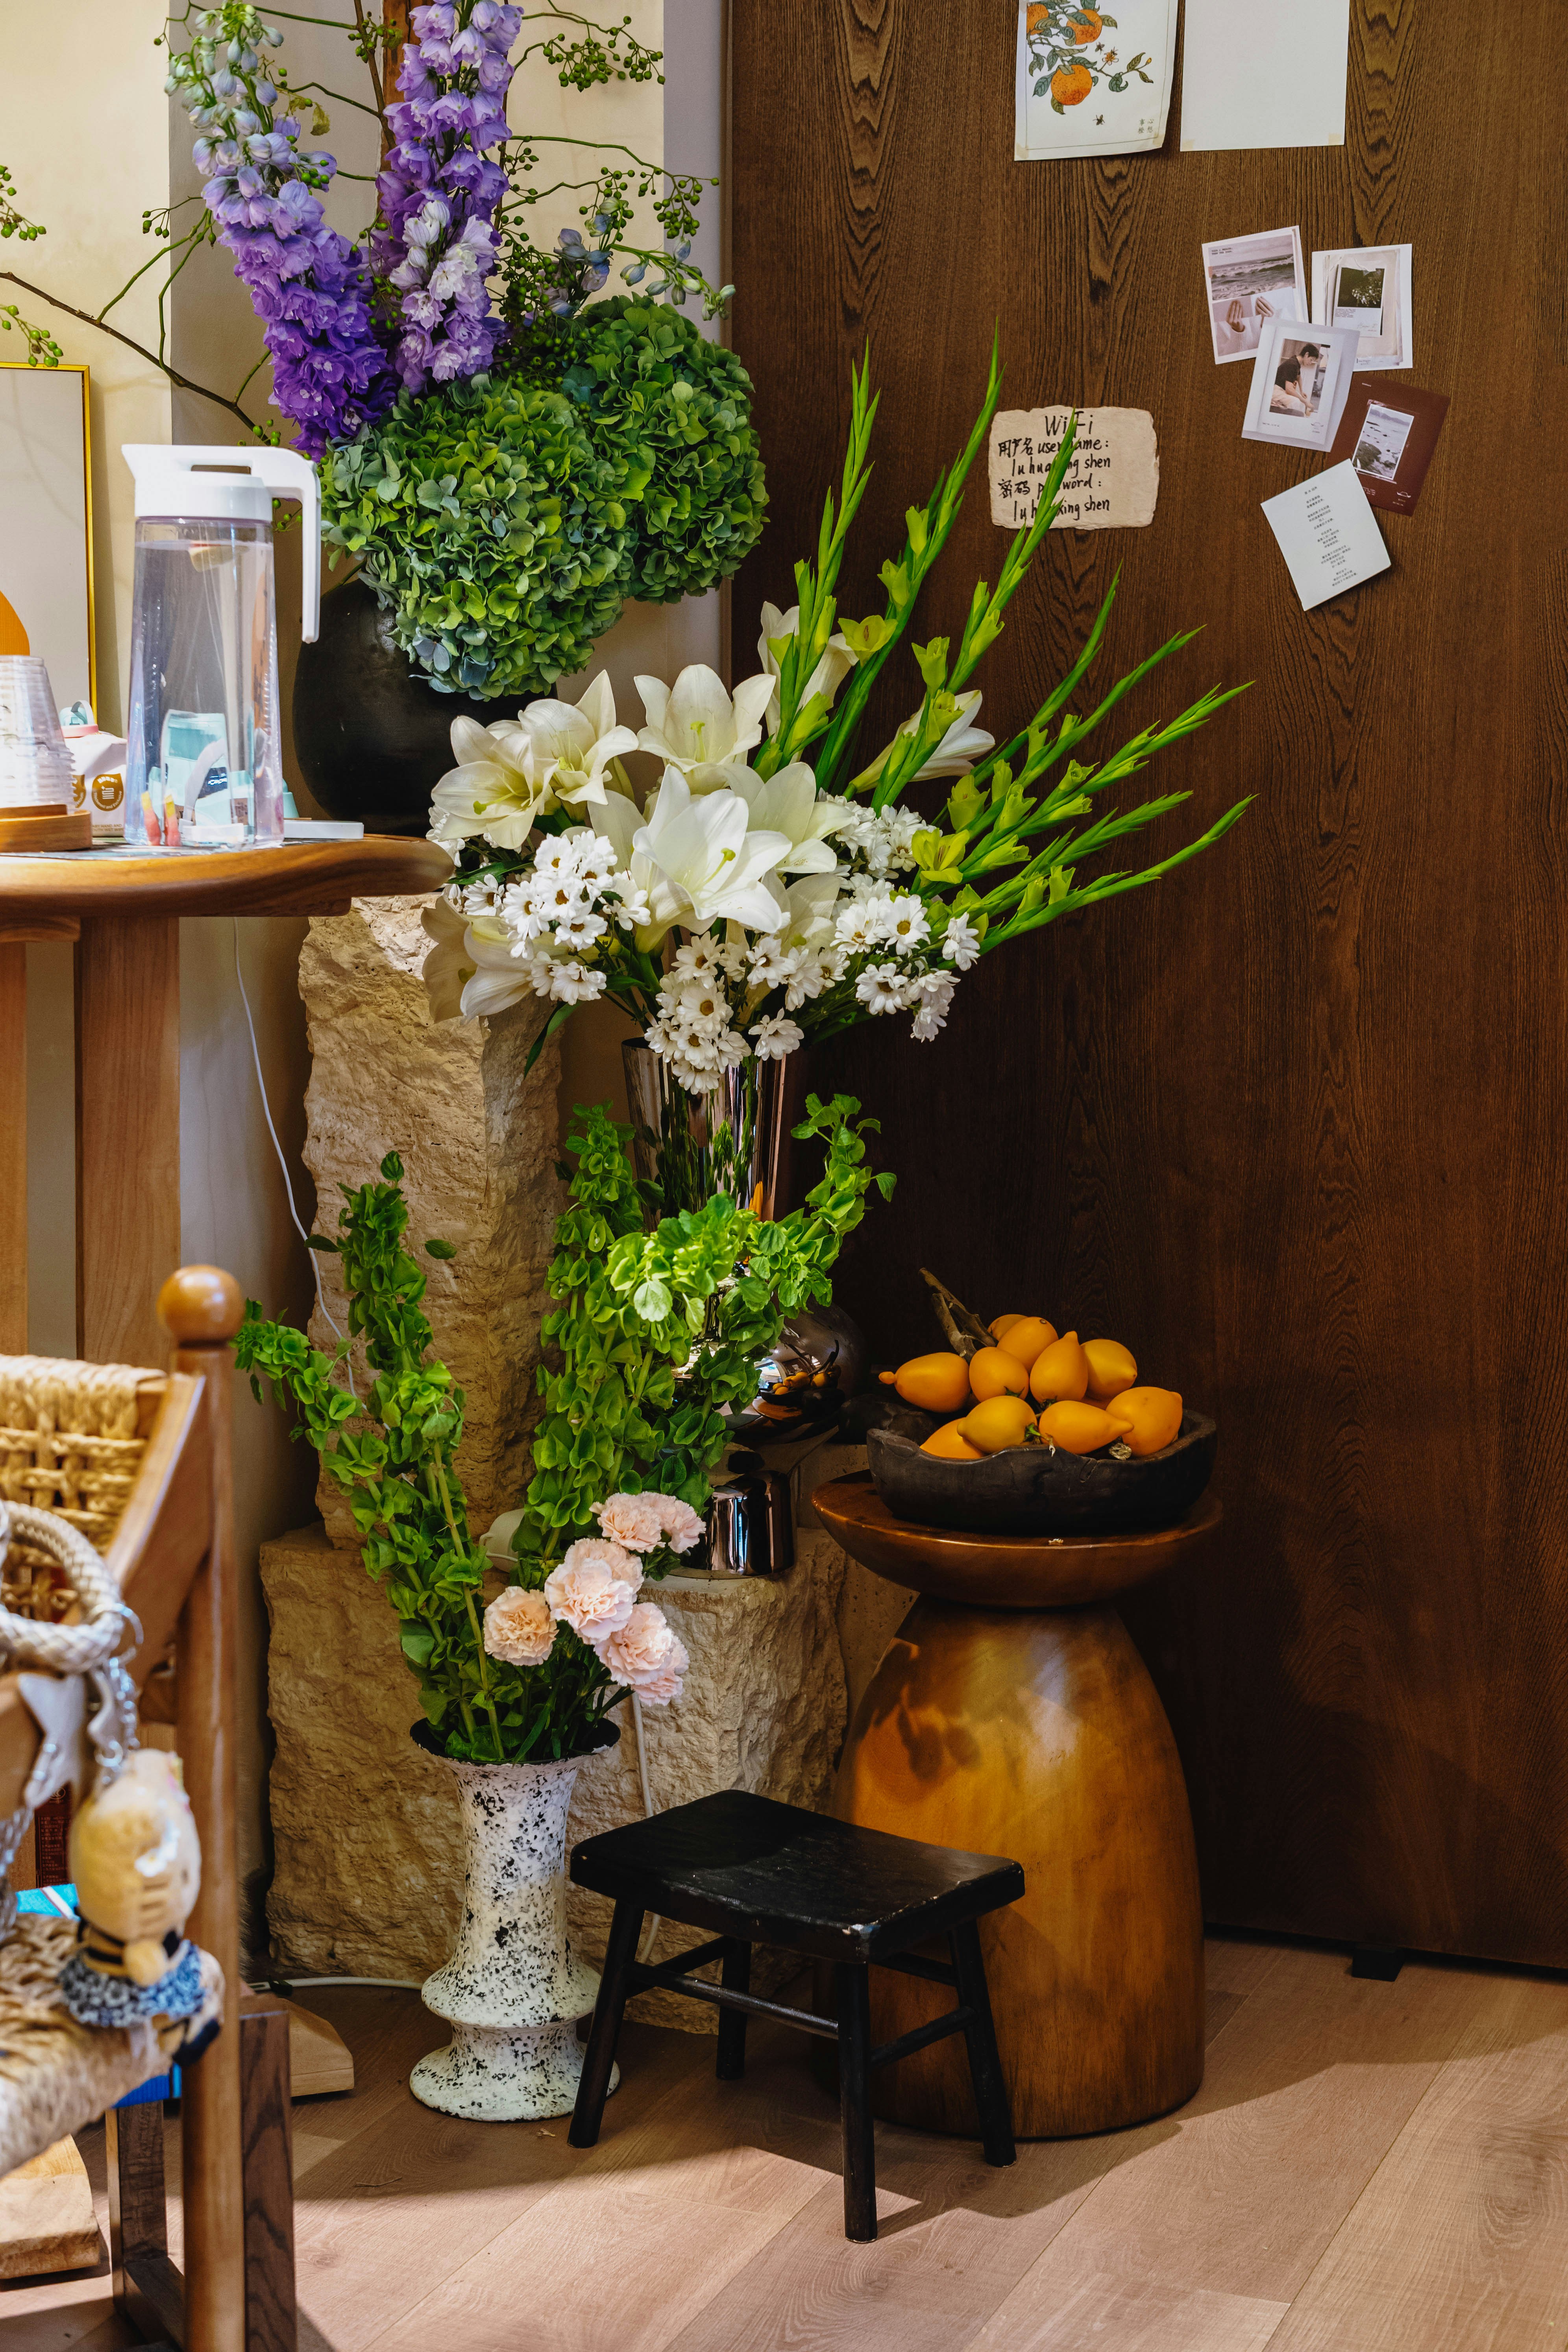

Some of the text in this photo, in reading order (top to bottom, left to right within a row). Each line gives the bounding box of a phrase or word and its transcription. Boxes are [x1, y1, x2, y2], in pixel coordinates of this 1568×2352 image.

[1038, 439, 1108, 453] userame:
[1084, 453, 1110, 468] shen
[998, 473, 1101, 500] 密码 pword:
[1031, 499, 1080, 520] hxing
[1084, 495, 1110, 511] shen
